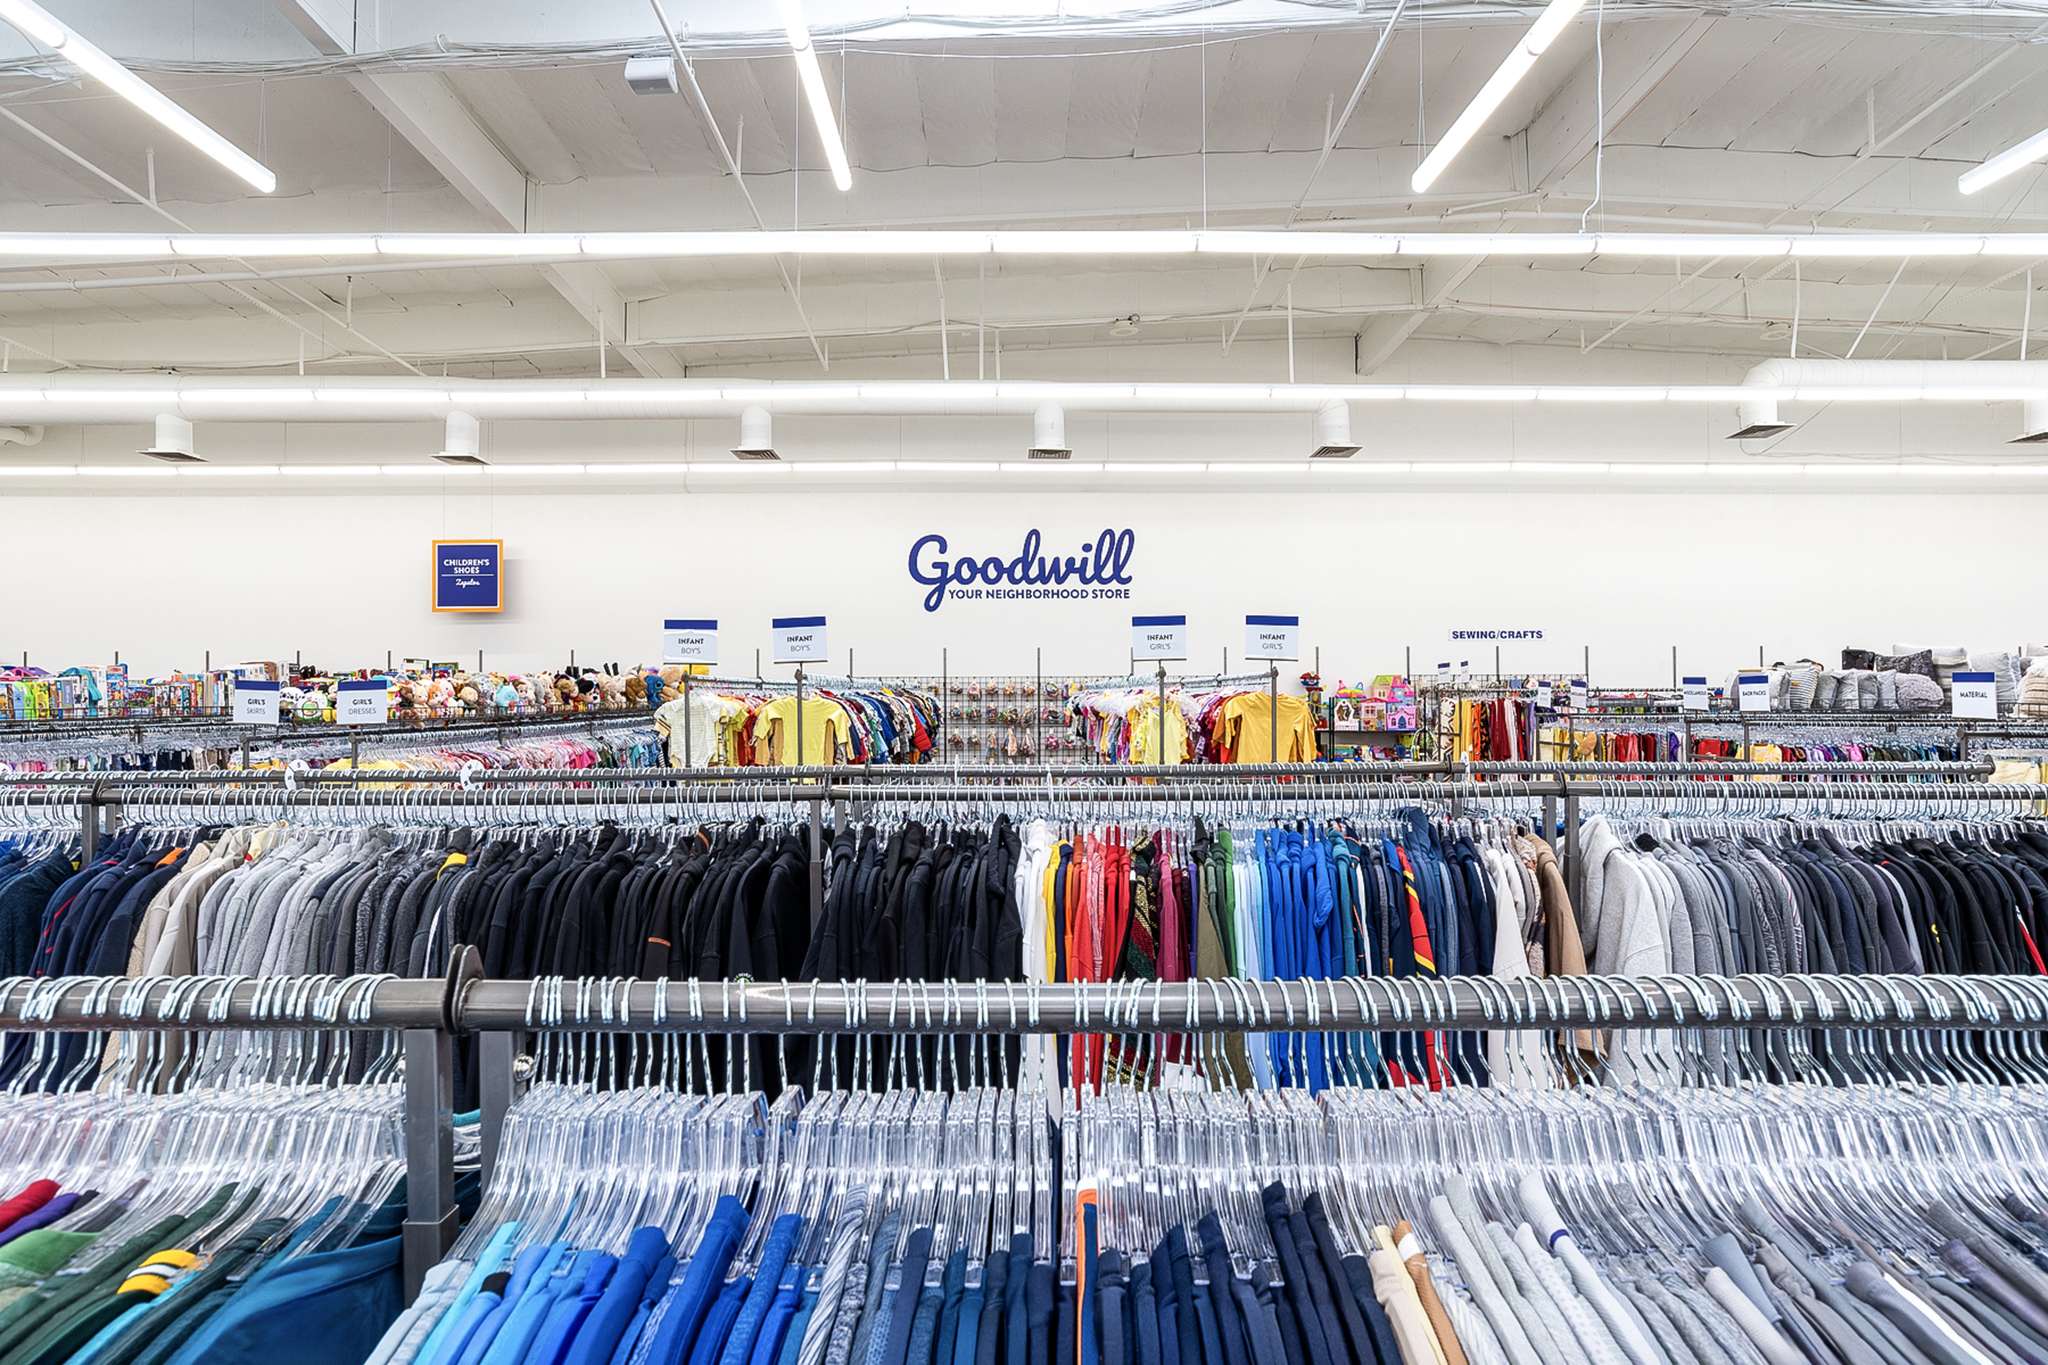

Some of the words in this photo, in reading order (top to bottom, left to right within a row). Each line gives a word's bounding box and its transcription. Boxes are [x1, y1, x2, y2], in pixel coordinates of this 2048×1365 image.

[453, 566, 480, 574] SHOES
[908, 528, 1135, 612] Goodwill
[948, 589, 982, 599] YOUR
[986, 589, 1089, 599] NEIGHBORHOOD
[1091, 588, 1130, 599] STORE
[1452, 630, 1543, 640] SEWING/CRAFTS
[1262, 642, 1283, 650] GIRL'S
